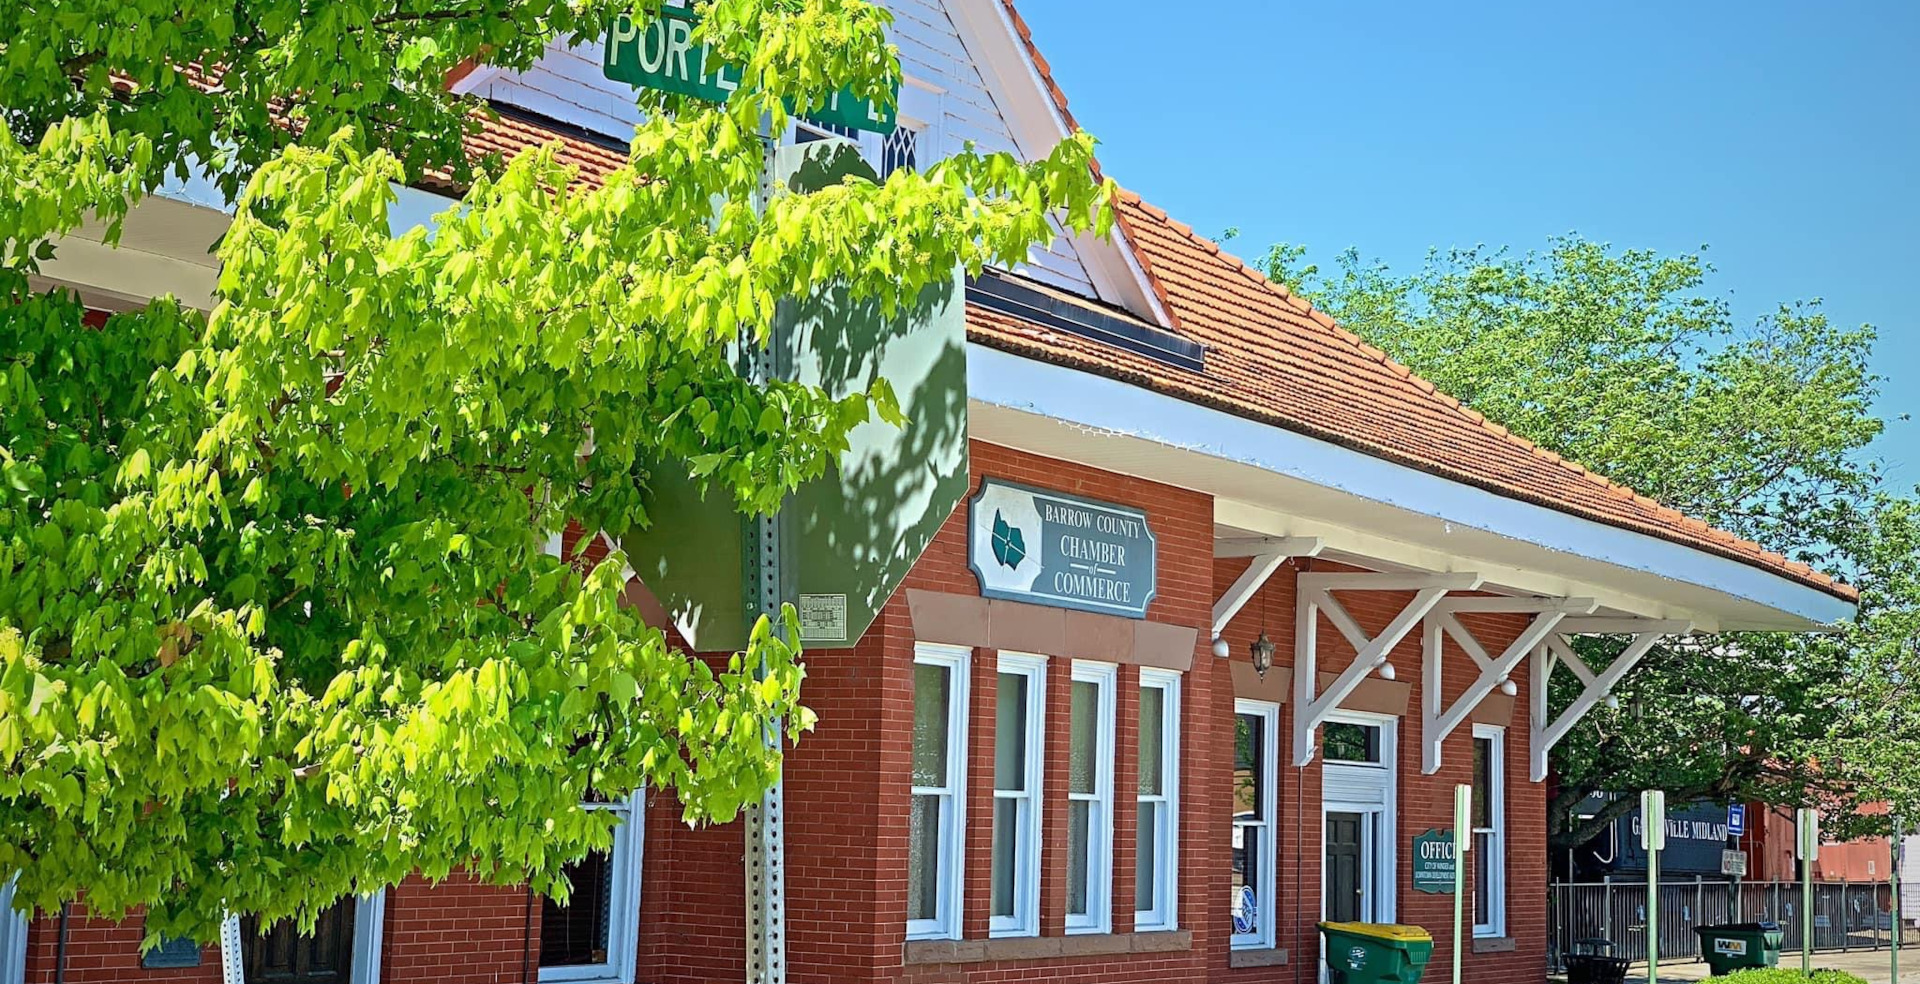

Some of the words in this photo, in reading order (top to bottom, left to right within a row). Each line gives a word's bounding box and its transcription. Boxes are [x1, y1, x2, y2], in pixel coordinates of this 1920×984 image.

[1045, 504, 1093, 529] BARROW
[1096, 514, 1141, 539] COUNTY
[1060, 534, 1126, 567] CHAMBER
[1088, 562, 1098, 576] of
[1054, 571, 1131, 603] COMMERCE
[1691, 821, 1728, 842] MIDLAND
